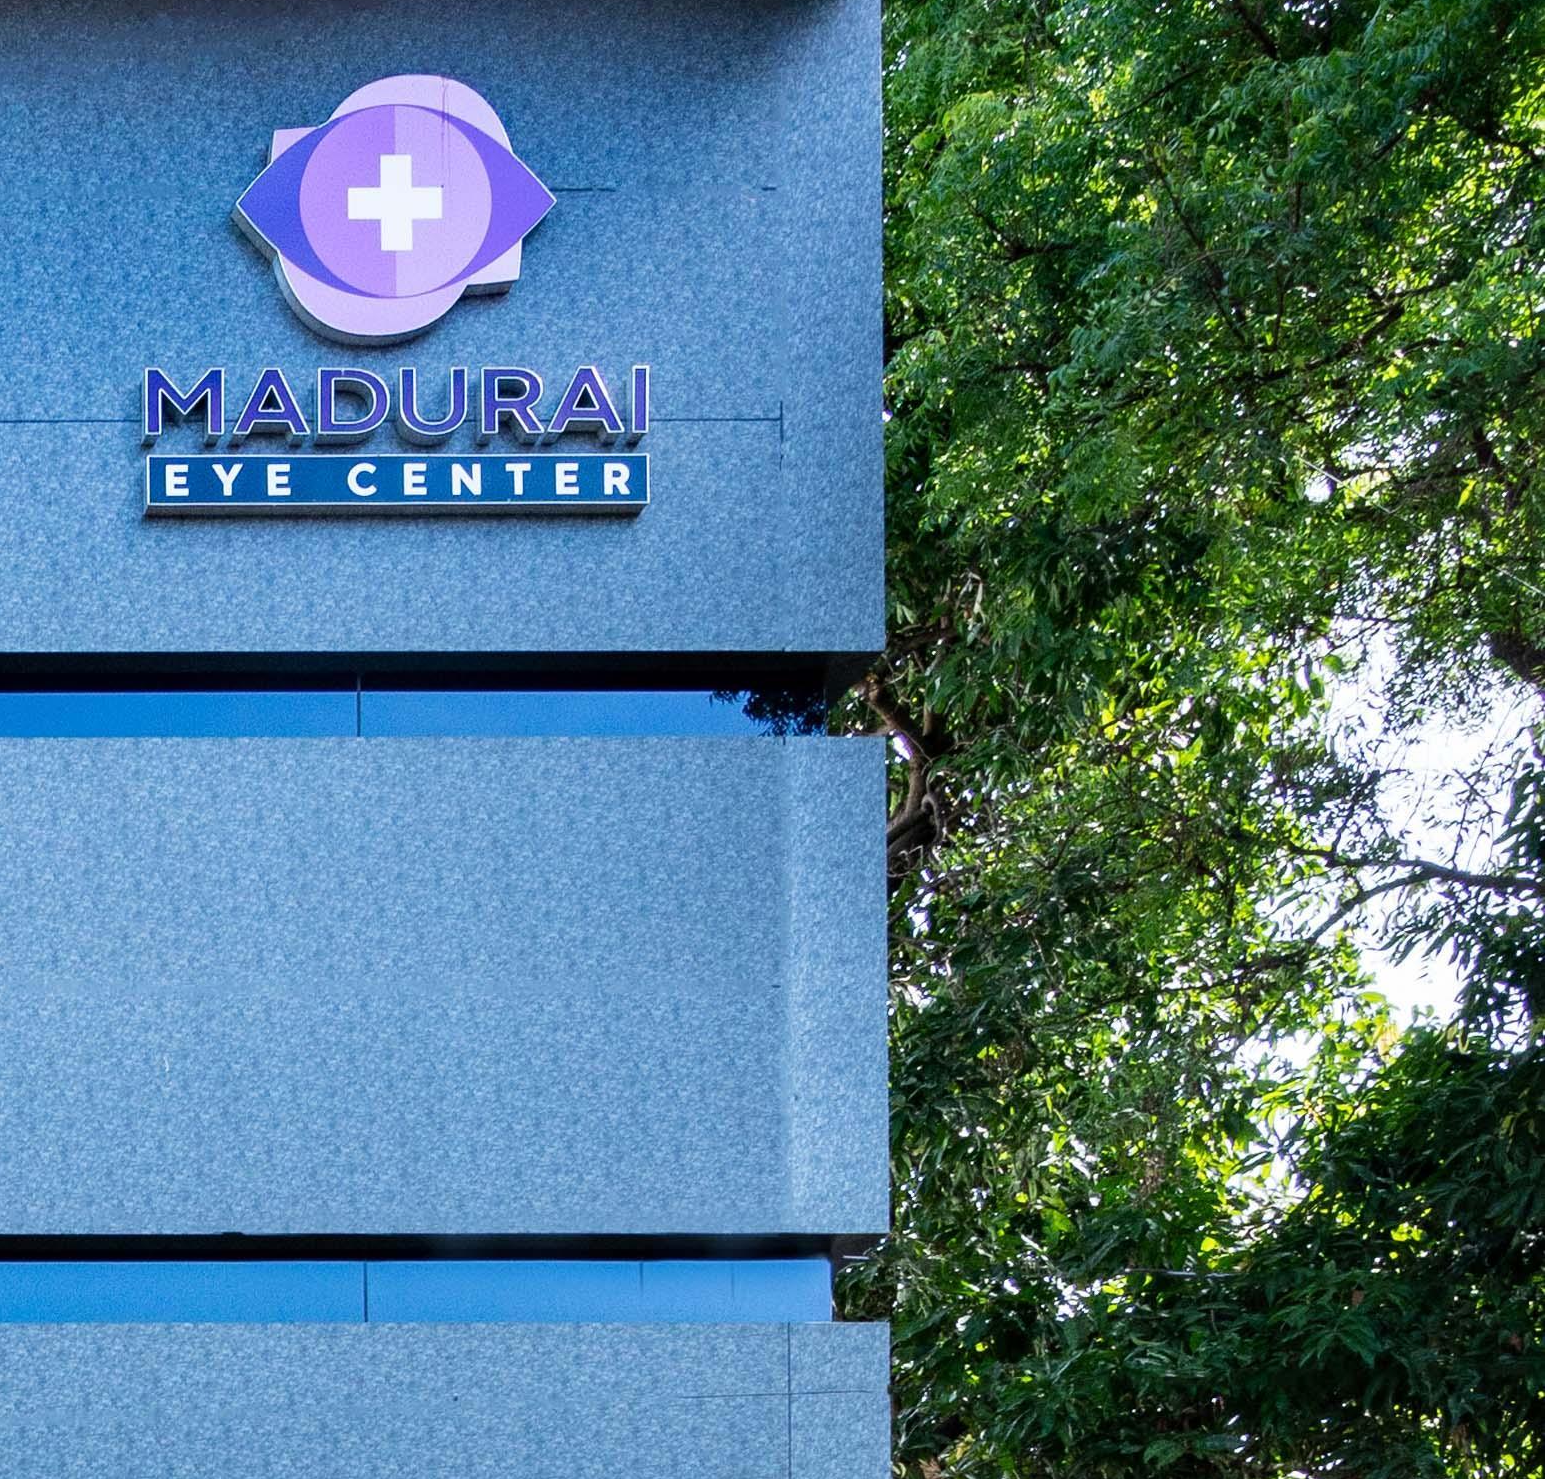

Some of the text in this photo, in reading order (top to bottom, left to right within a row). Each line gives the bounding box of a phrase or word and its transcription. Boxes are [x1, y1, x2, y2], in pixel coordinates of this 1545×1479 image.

[145, 365, 649, 436] MADURAI
[165, 462, 630, 497] EYE CENTER
